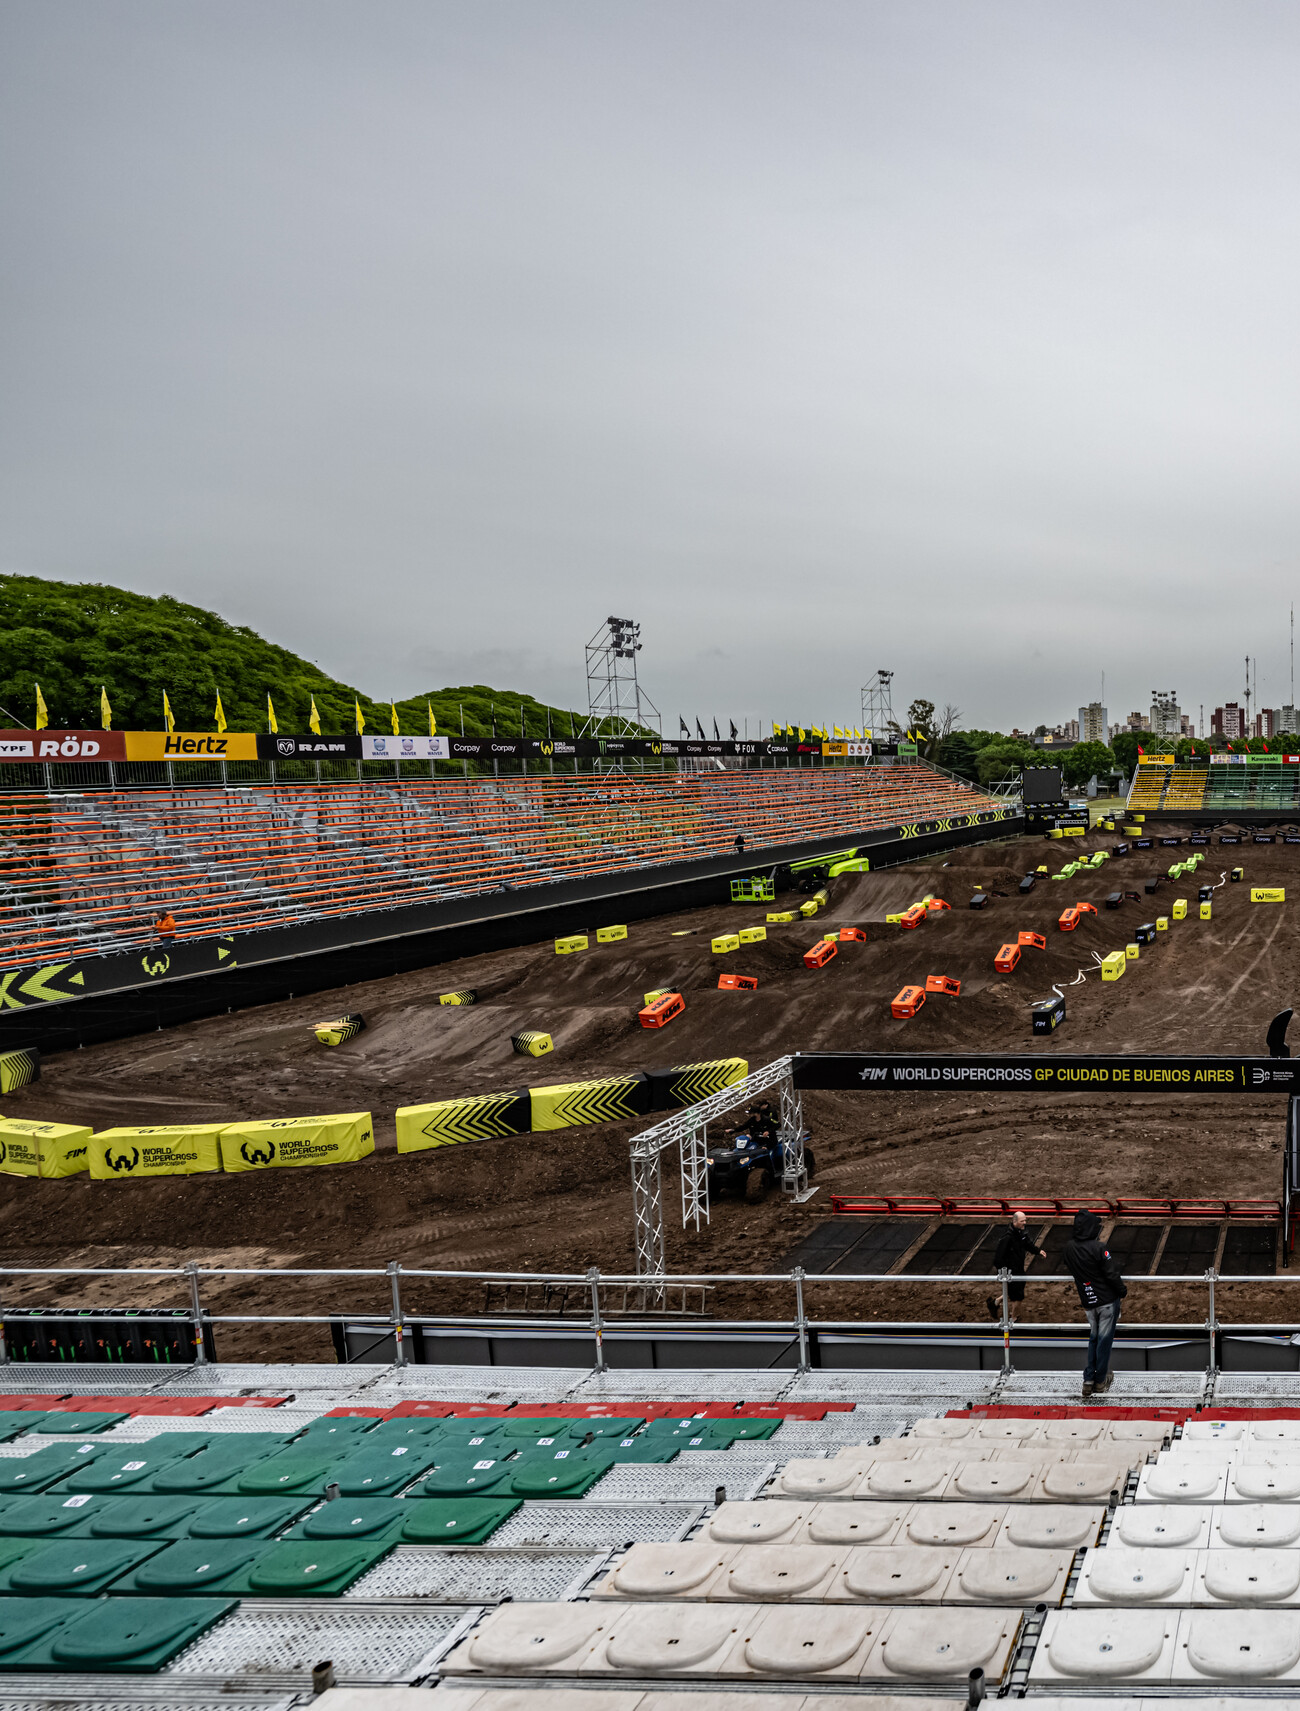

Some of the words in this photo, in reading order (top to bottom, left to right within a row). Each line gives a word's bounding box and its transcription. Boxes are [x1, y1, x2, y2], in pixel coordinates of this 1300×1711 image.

[39, 735, 101, 757] RÖD
[164, 735, 229, 754] Hertz
[298, 743, 346, 752] RAM
[453, 743, 481, 753] Corpay
[491, 743, 516, 753] Corpay
[742, 744, 756, 753] FOX
[829, 744, 843, 753] Hertz
[661, 1001, 682, 1021] KTM
[858, 1067, 888, 1081] FIM
[893, 1067, 941, 1081] WORLD
[942, 1068, 1032, 1082] SUPERCROSS
[1034, 1068, 1054, 1082] GP
[1057, 1068, 1109, 1082] CIUDAD
[1112, 1069, 1130, 1082] DE
[1134, 1069, 1191, 1083] BUENOS
[1193, 1069, 1235, 1083] AIRES
[8, 1144, 28, 1152] WORLD
[278, 1140, 311, 1149] WORLD
[63, 1146, 88, 1160] FIM
[142, 1147, 172, 1156] WORLD
[279, 1144, 339, 1156] SUPERCROSS
[142, 1153, 198, 1163] SUPERCROSS
[279, 1151, 329, 1162] CHAMPIONSHIP
